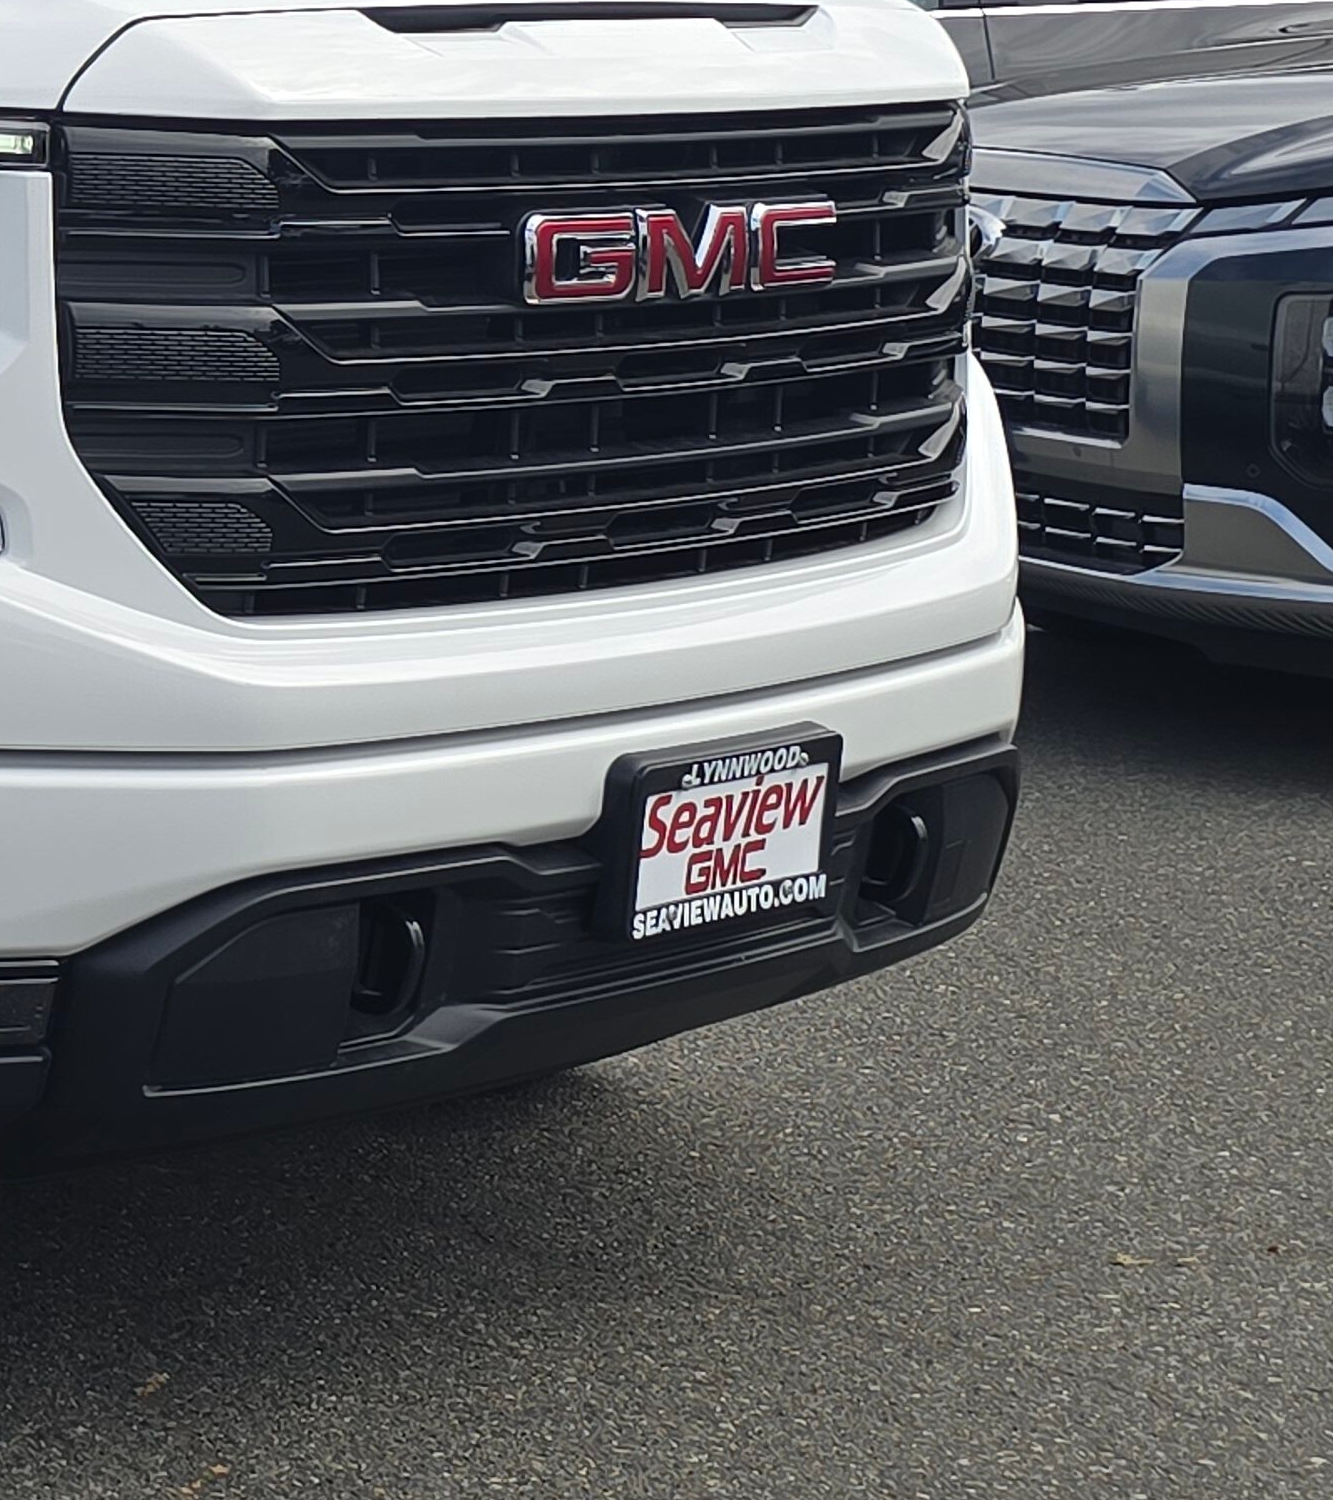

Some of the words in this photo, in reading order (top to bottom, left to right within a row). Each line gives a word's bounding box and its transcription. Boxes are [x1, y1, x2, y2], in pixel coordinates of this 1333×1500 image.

[524, 200, 836, 305] GMC
[690, 745, 802, 787] LYNNWOOD
[638, 775, 825, 860] Seaview
[684, 838, 767, 896] GMC
[632, 873, 827, 940] SEAVIEWAUTO.COM
